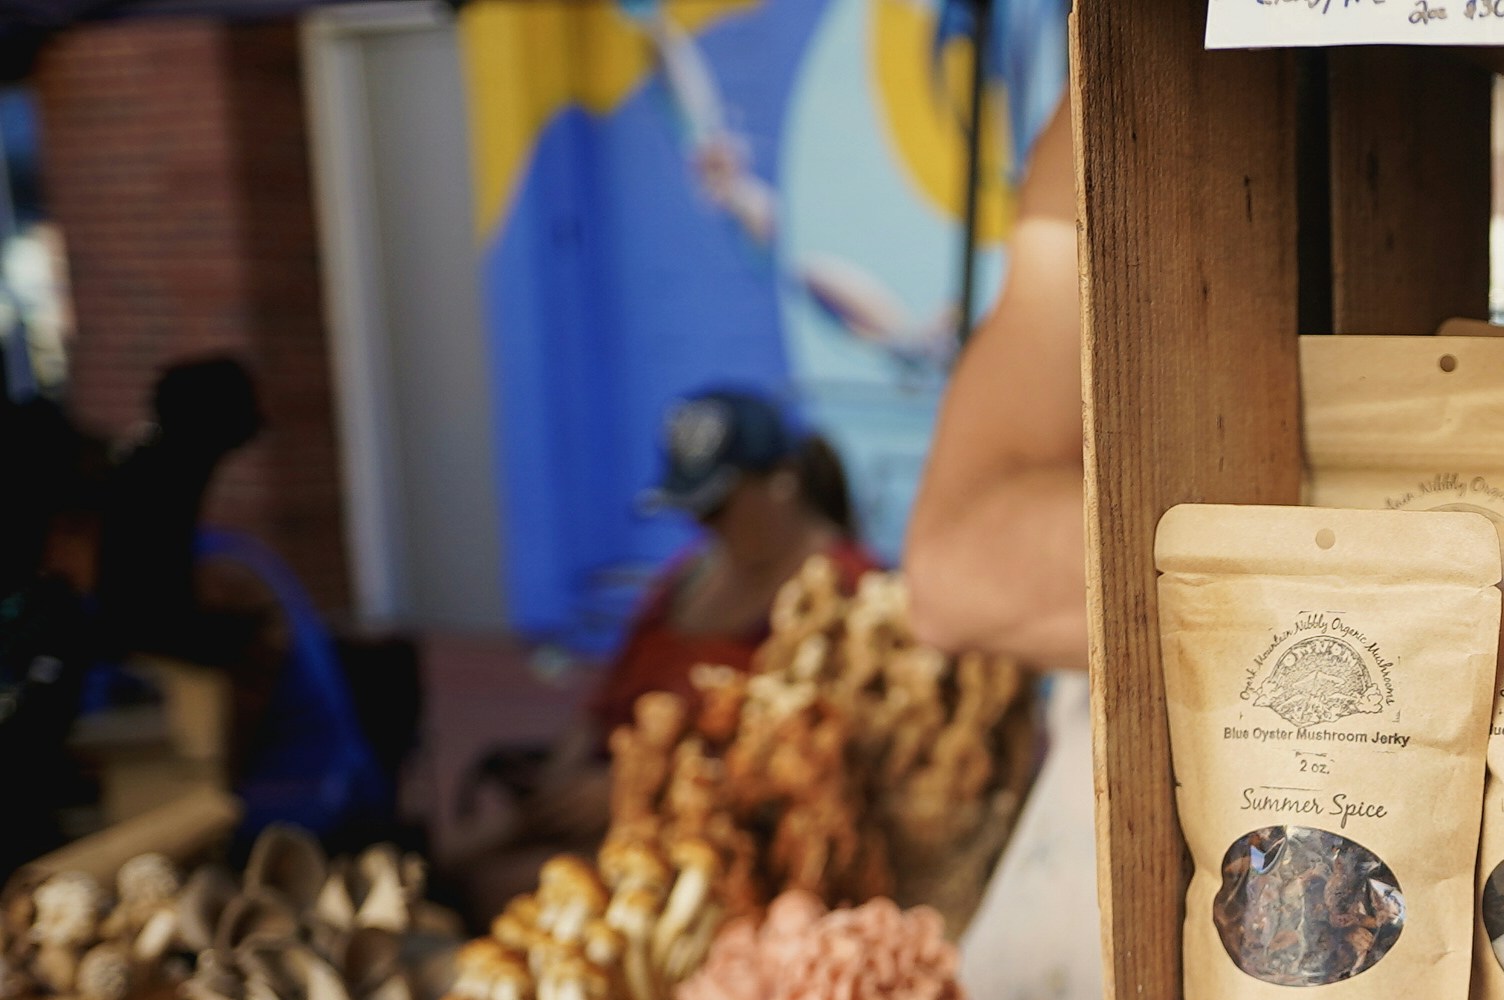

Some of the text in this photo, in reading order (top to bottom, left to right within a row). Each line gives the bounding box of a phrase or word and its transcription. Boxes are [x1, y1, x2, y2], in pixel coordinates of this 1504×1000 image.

[1293, 613, 1328, 636] Nibbly
[1331, 617, 1368, 645] Organic
[1364, 642, 1396, 706] Mushrooms
[1223, 727, 1411, 747] Blue Oyster Mushroom Jerky
[1299, 759, 1330, 775] 2 oz.
[1240, 788, 1388, 829] Summer Spice
